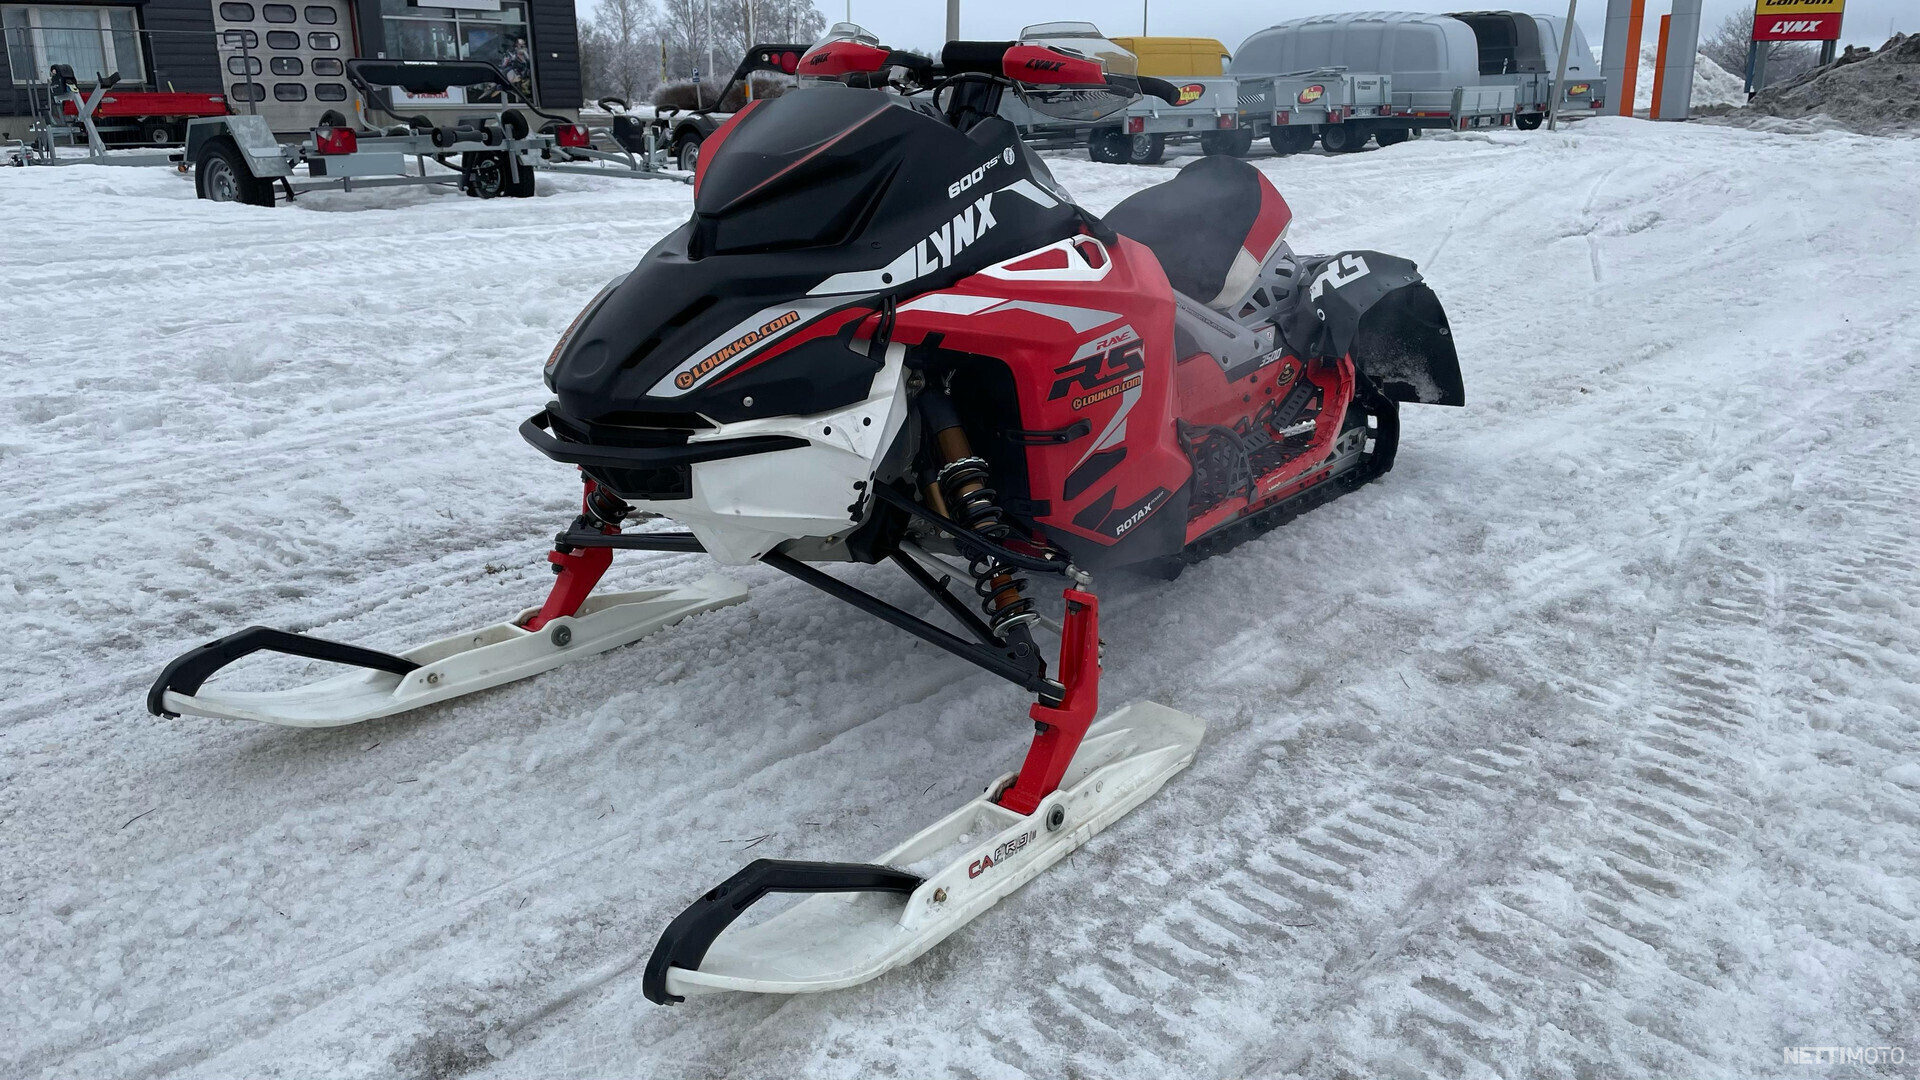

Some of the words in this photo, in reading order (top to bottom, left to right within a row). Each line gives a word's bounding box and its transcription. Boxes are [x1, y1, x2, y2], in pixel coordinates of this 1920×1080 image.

[1769, 20, 1823, 34] LYNX
[1025, 58, 1066, 73] LYNX
[917, 192, 997, 278] LYNX
[691, 310, 800, 379] LOUKKO.com
[1096, 331, 1131, 351] RAVE
[1047, 339, 1145, 401] RS
[1259, 347, 1283, 368] 3500
[1081, 376, 1141, 407] LOUKKO.com
[1115, 502, 1152, 536] ROTAX
